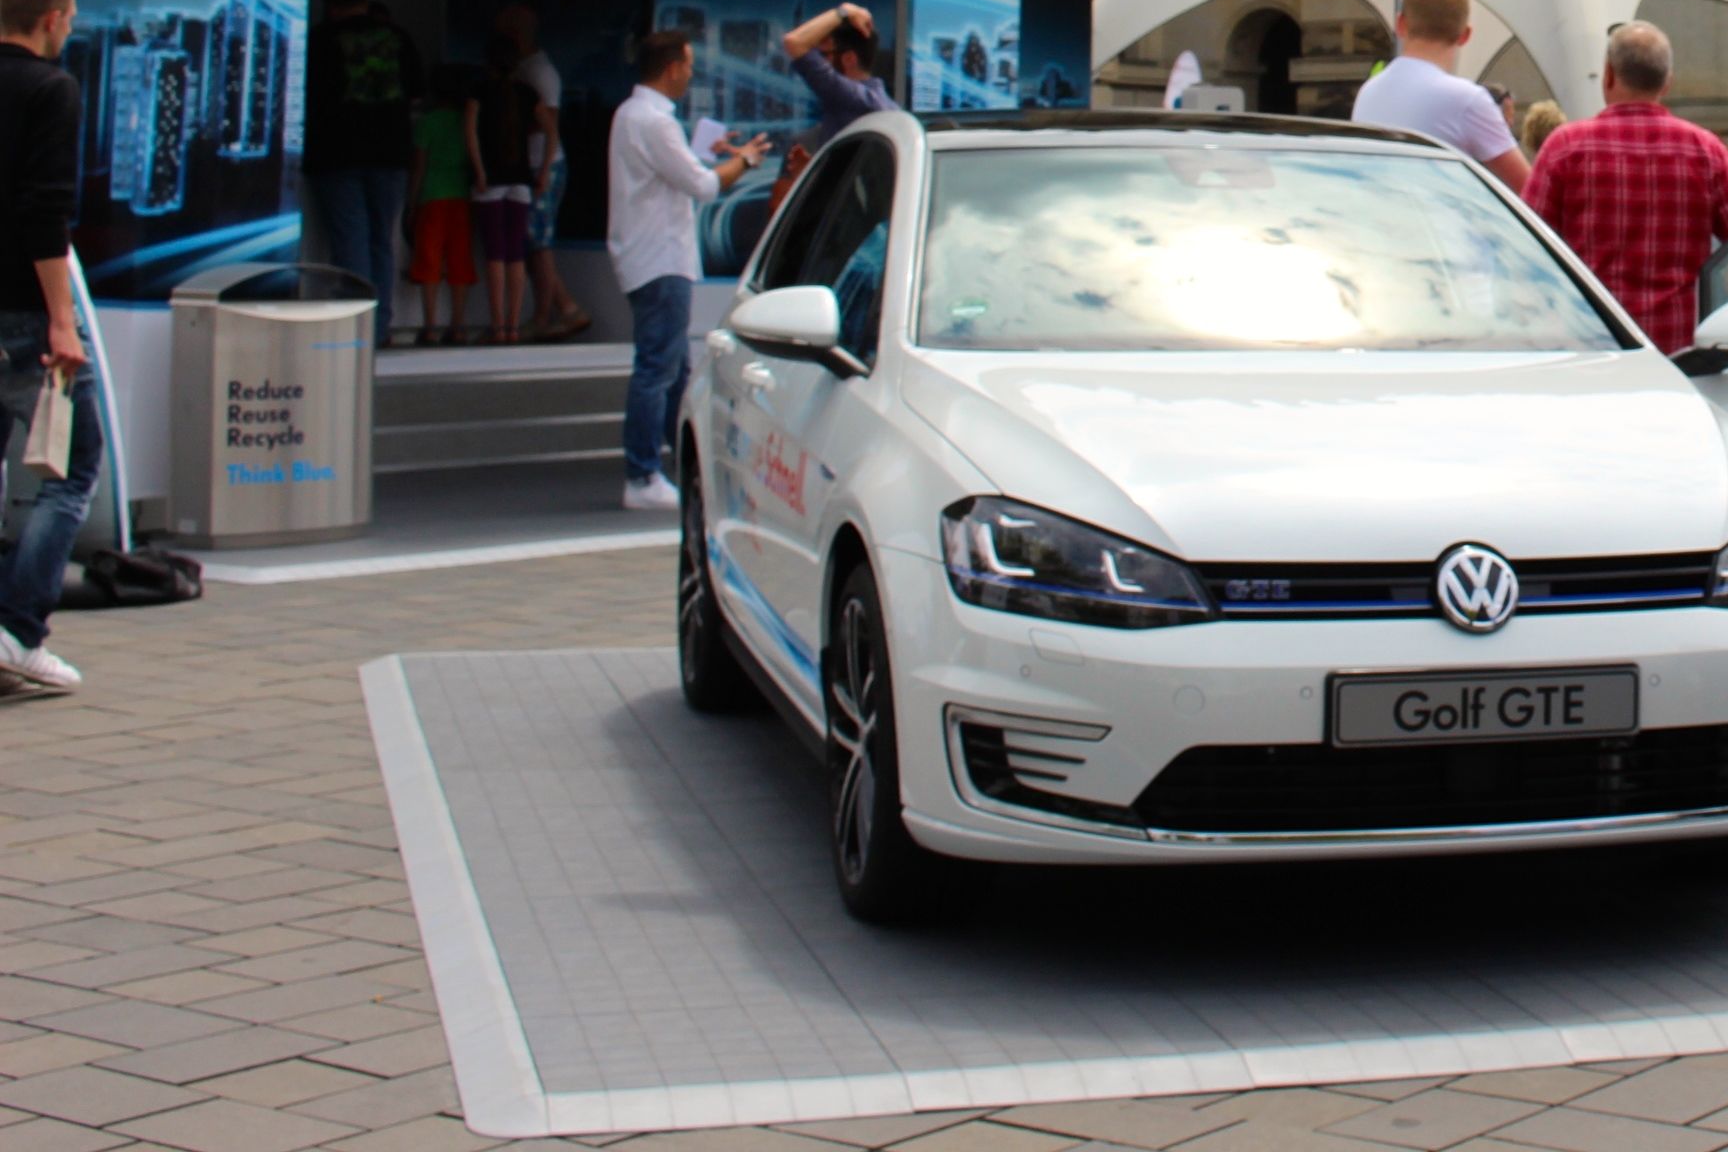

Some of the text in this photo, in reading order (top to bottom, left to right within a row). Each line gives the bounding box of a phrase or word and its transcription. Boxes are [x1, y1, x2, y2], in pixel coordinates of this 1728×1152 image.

[228, 378, 305, 401] Reduce
[227, 404, 291, 424] Reuse
[227, 425, 305, 452] Recycle
[226, 462, 285, 486] Think
[1225, 579, 1291, 601] GTE
[1393, 685, 1586, 732] Golf GTE
